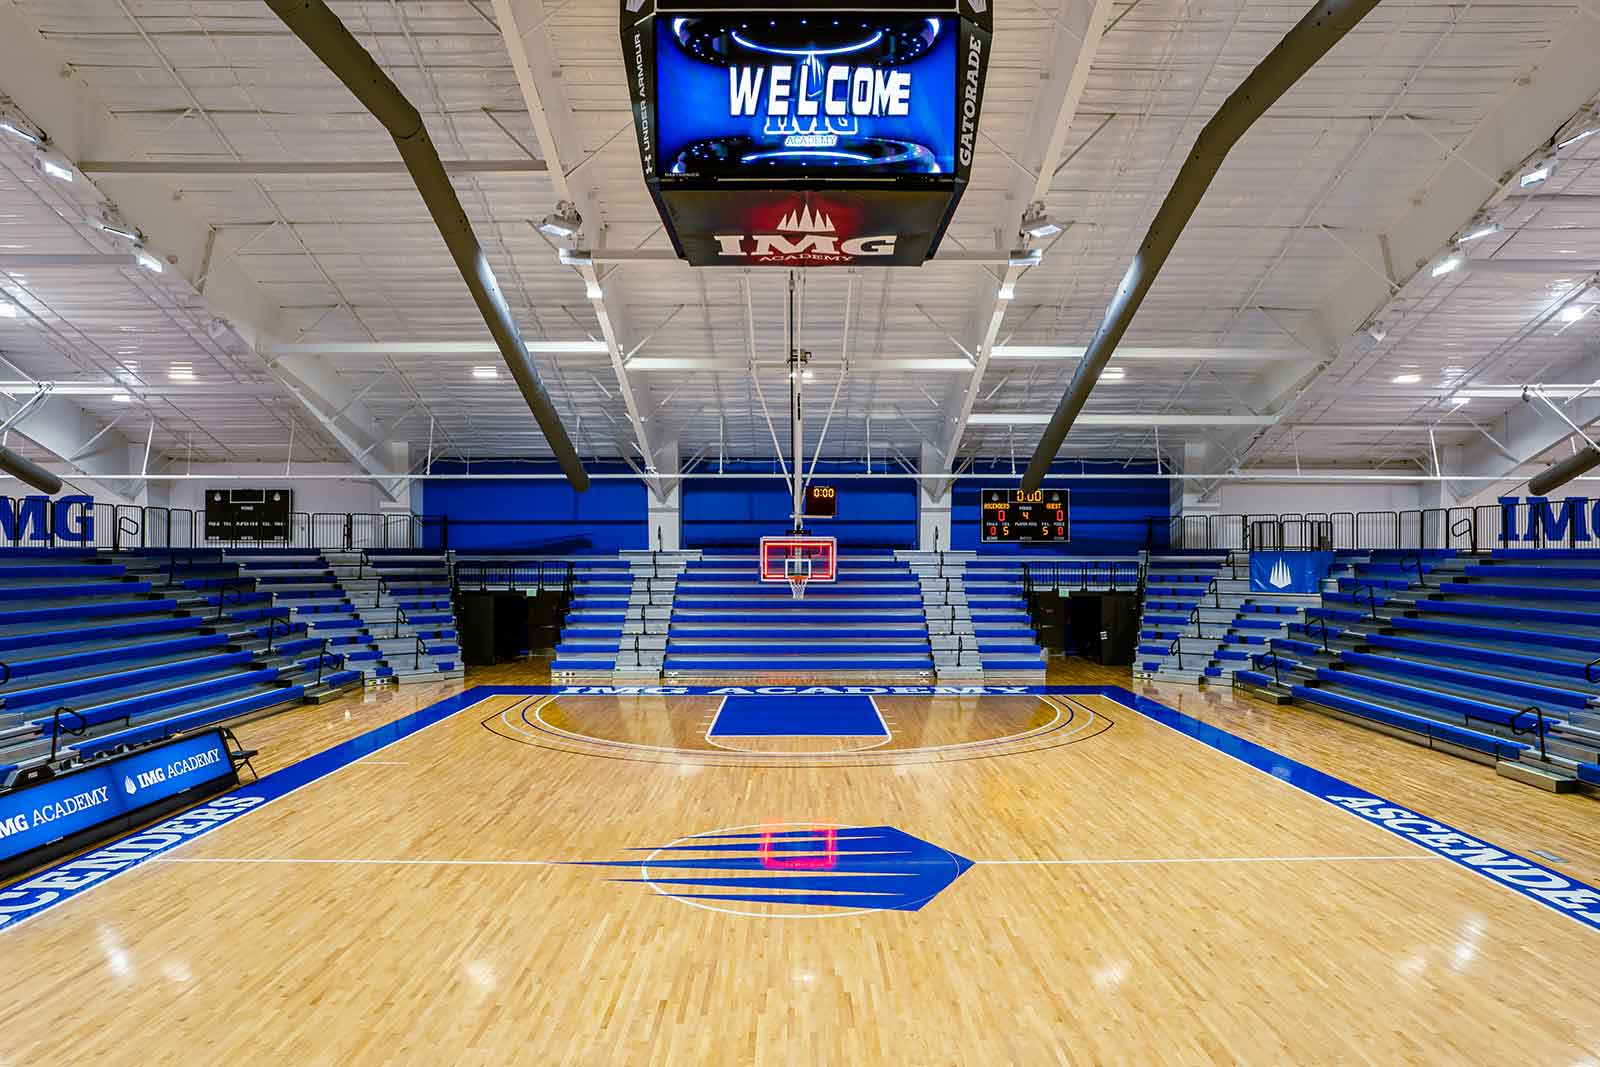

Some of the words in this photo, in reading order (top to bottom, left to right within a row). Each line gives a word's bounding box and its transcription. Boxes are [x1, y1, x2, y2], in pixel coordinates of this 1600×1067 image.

[634, 33, 646, 97] ARMOUR
[730, 66, 911, 116] WELCOME
[959, 36, 981, 166] GATORADE
[640, 100, 651, 151] UNDER
[786, 135, 836, 145] ACADEMY
[714, 234, 897, 256] IMG
[759, 254, 854, 262] ACADEMY
[814, 488, 835, 498] 0:00
[0, 495, 94, 541] MG
[998, 510, 1005, 521] 0
[1057, 510, 1063, 521] 0
[1497, 497, 1600, 541] IM
[137, 768, 166, 789] IMG
[168, 748, 220, 779] ACADEMY
[0, 813, 30, 839] MG
[33, 786, 109, 828] ACADEMY
[0, 796, 265, 925] CENDERS
